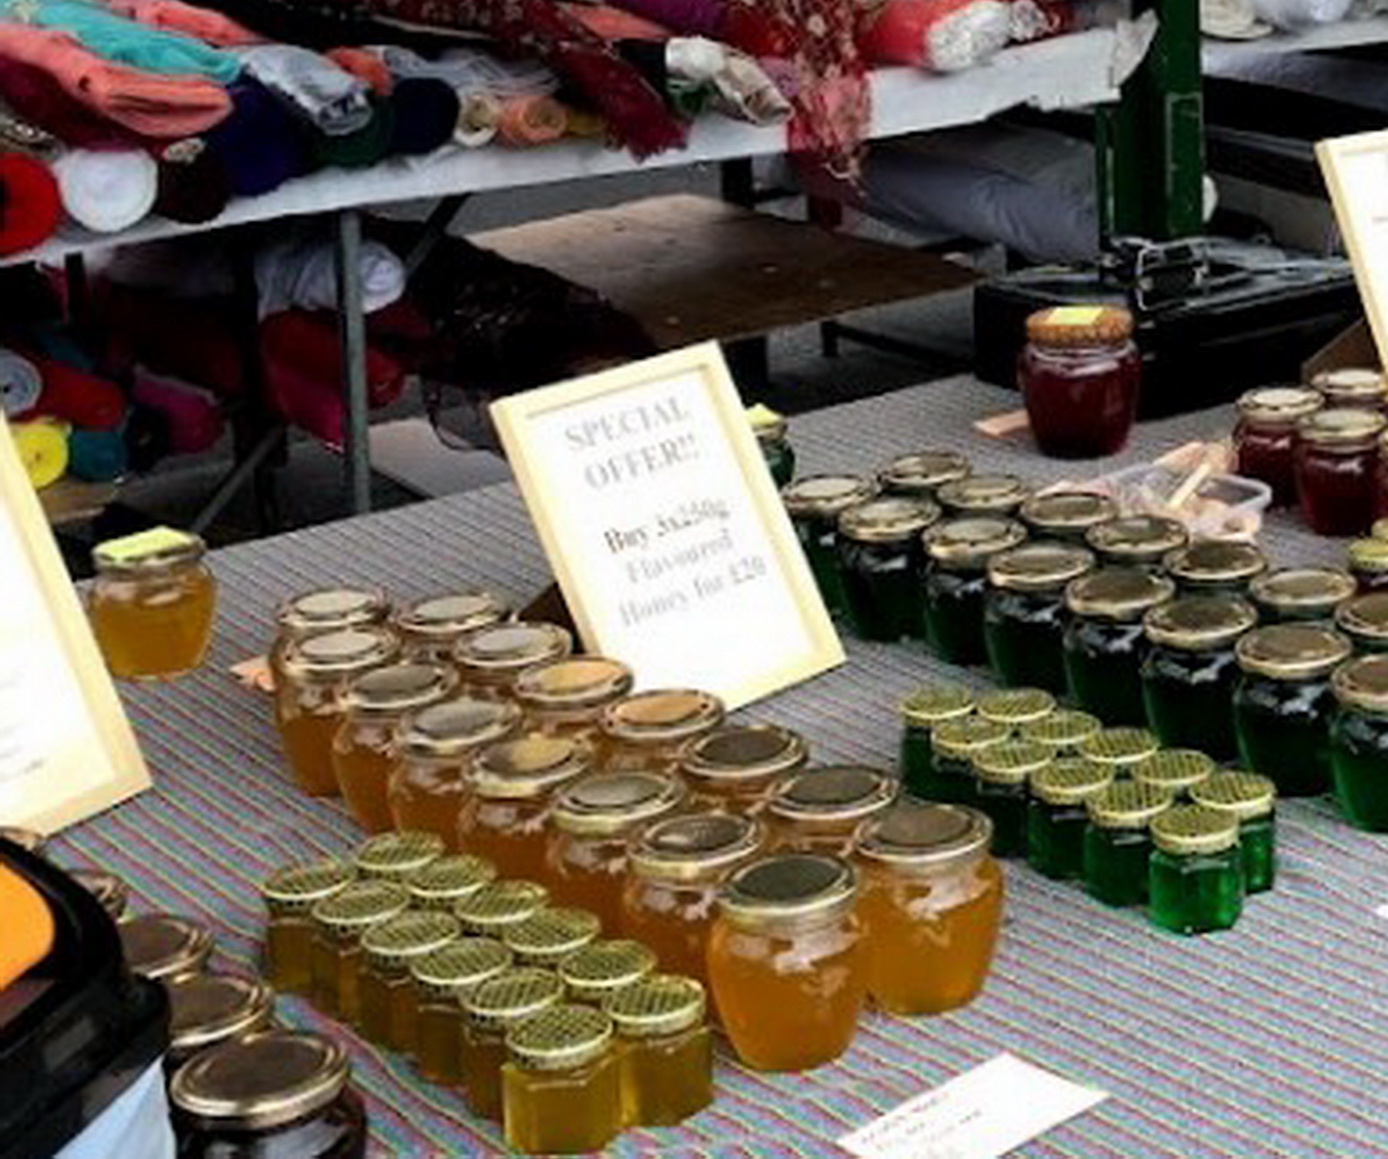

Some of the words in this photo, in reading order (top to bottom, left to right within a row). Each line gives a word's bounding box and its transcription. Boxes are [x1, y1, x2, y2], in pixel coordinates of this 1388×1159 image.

[564, 395, 690, 453] SPECIAL
[584, 434, 703, 491] OFFER!!
[604, 526, 649, 555] Buy
